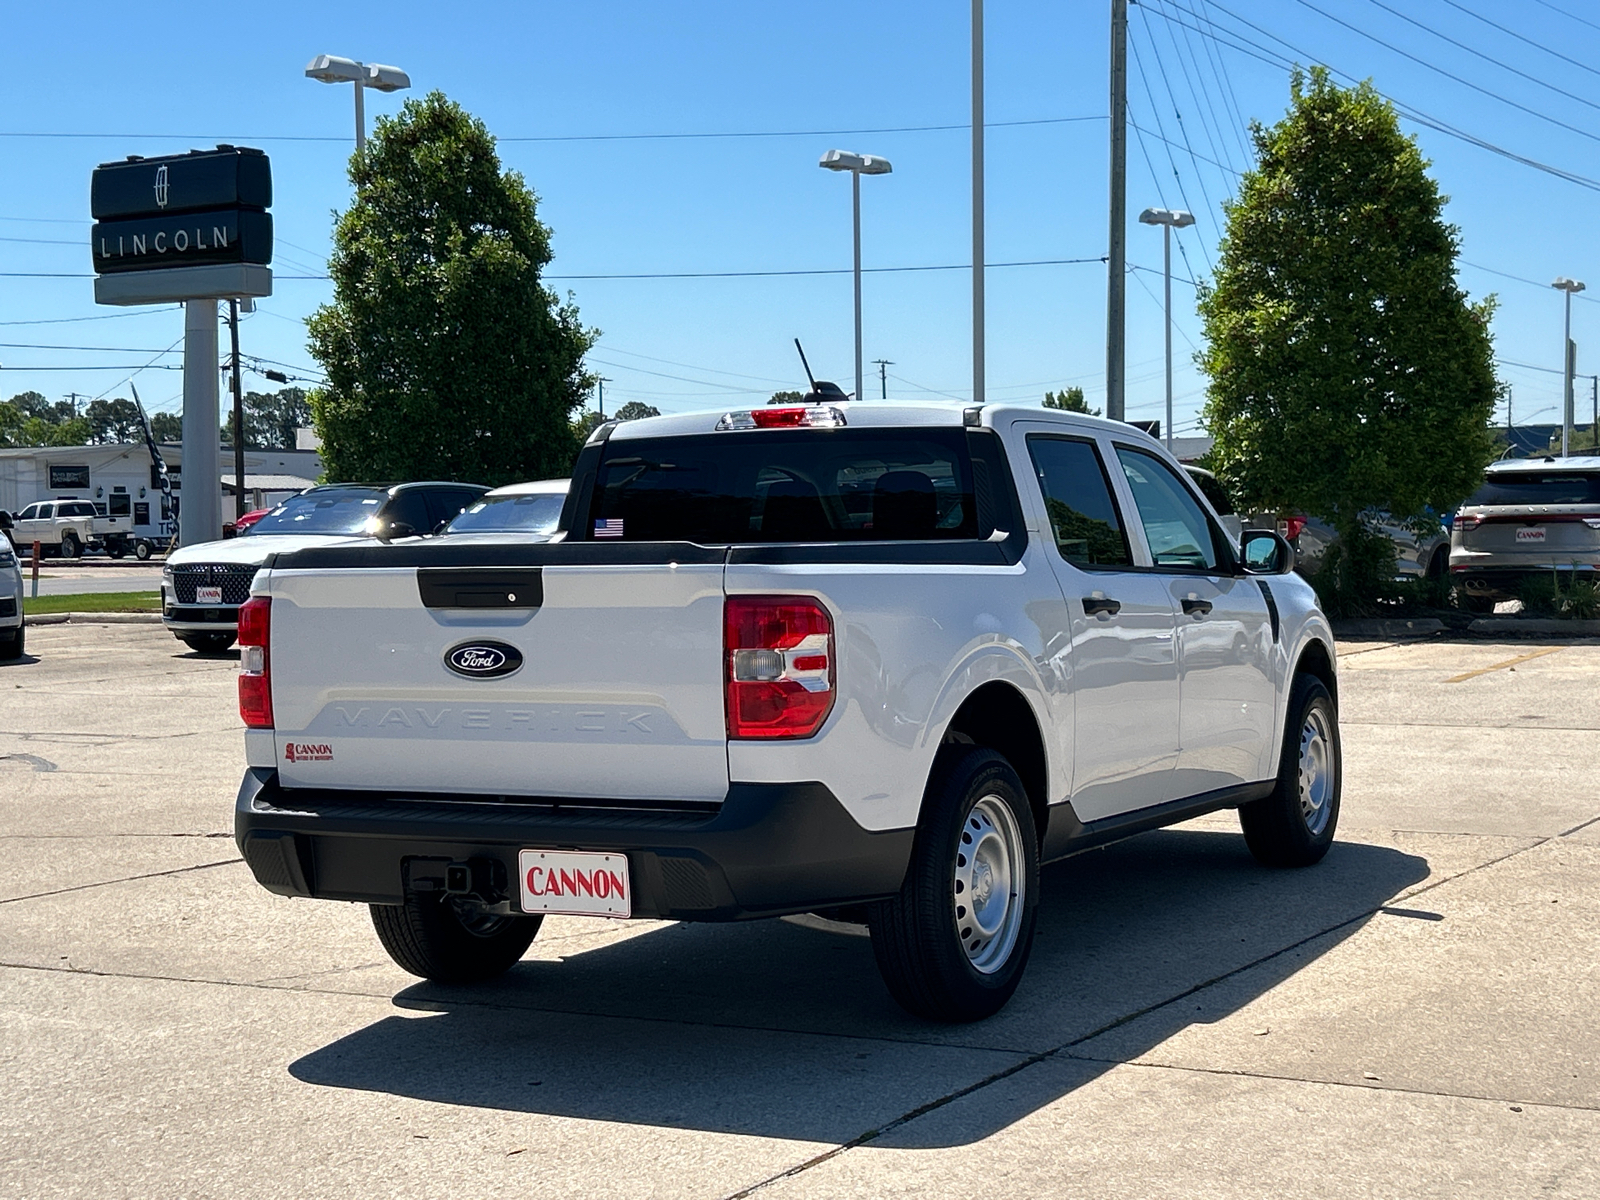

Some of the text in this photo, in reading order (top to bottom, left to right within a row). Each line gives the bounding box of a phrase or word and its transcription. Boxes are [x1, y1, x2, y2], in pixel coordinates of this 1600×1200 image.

[101, 226, 228, 258] LINCOLN
[198, 590, 221, 599] CANNON
[460, 650, 495, 667] Ford
[335, 706, 653, 734] MAVERICK
[295, 744, 333, 755] CANNON
[526, 866, 625, 901] CANNON
